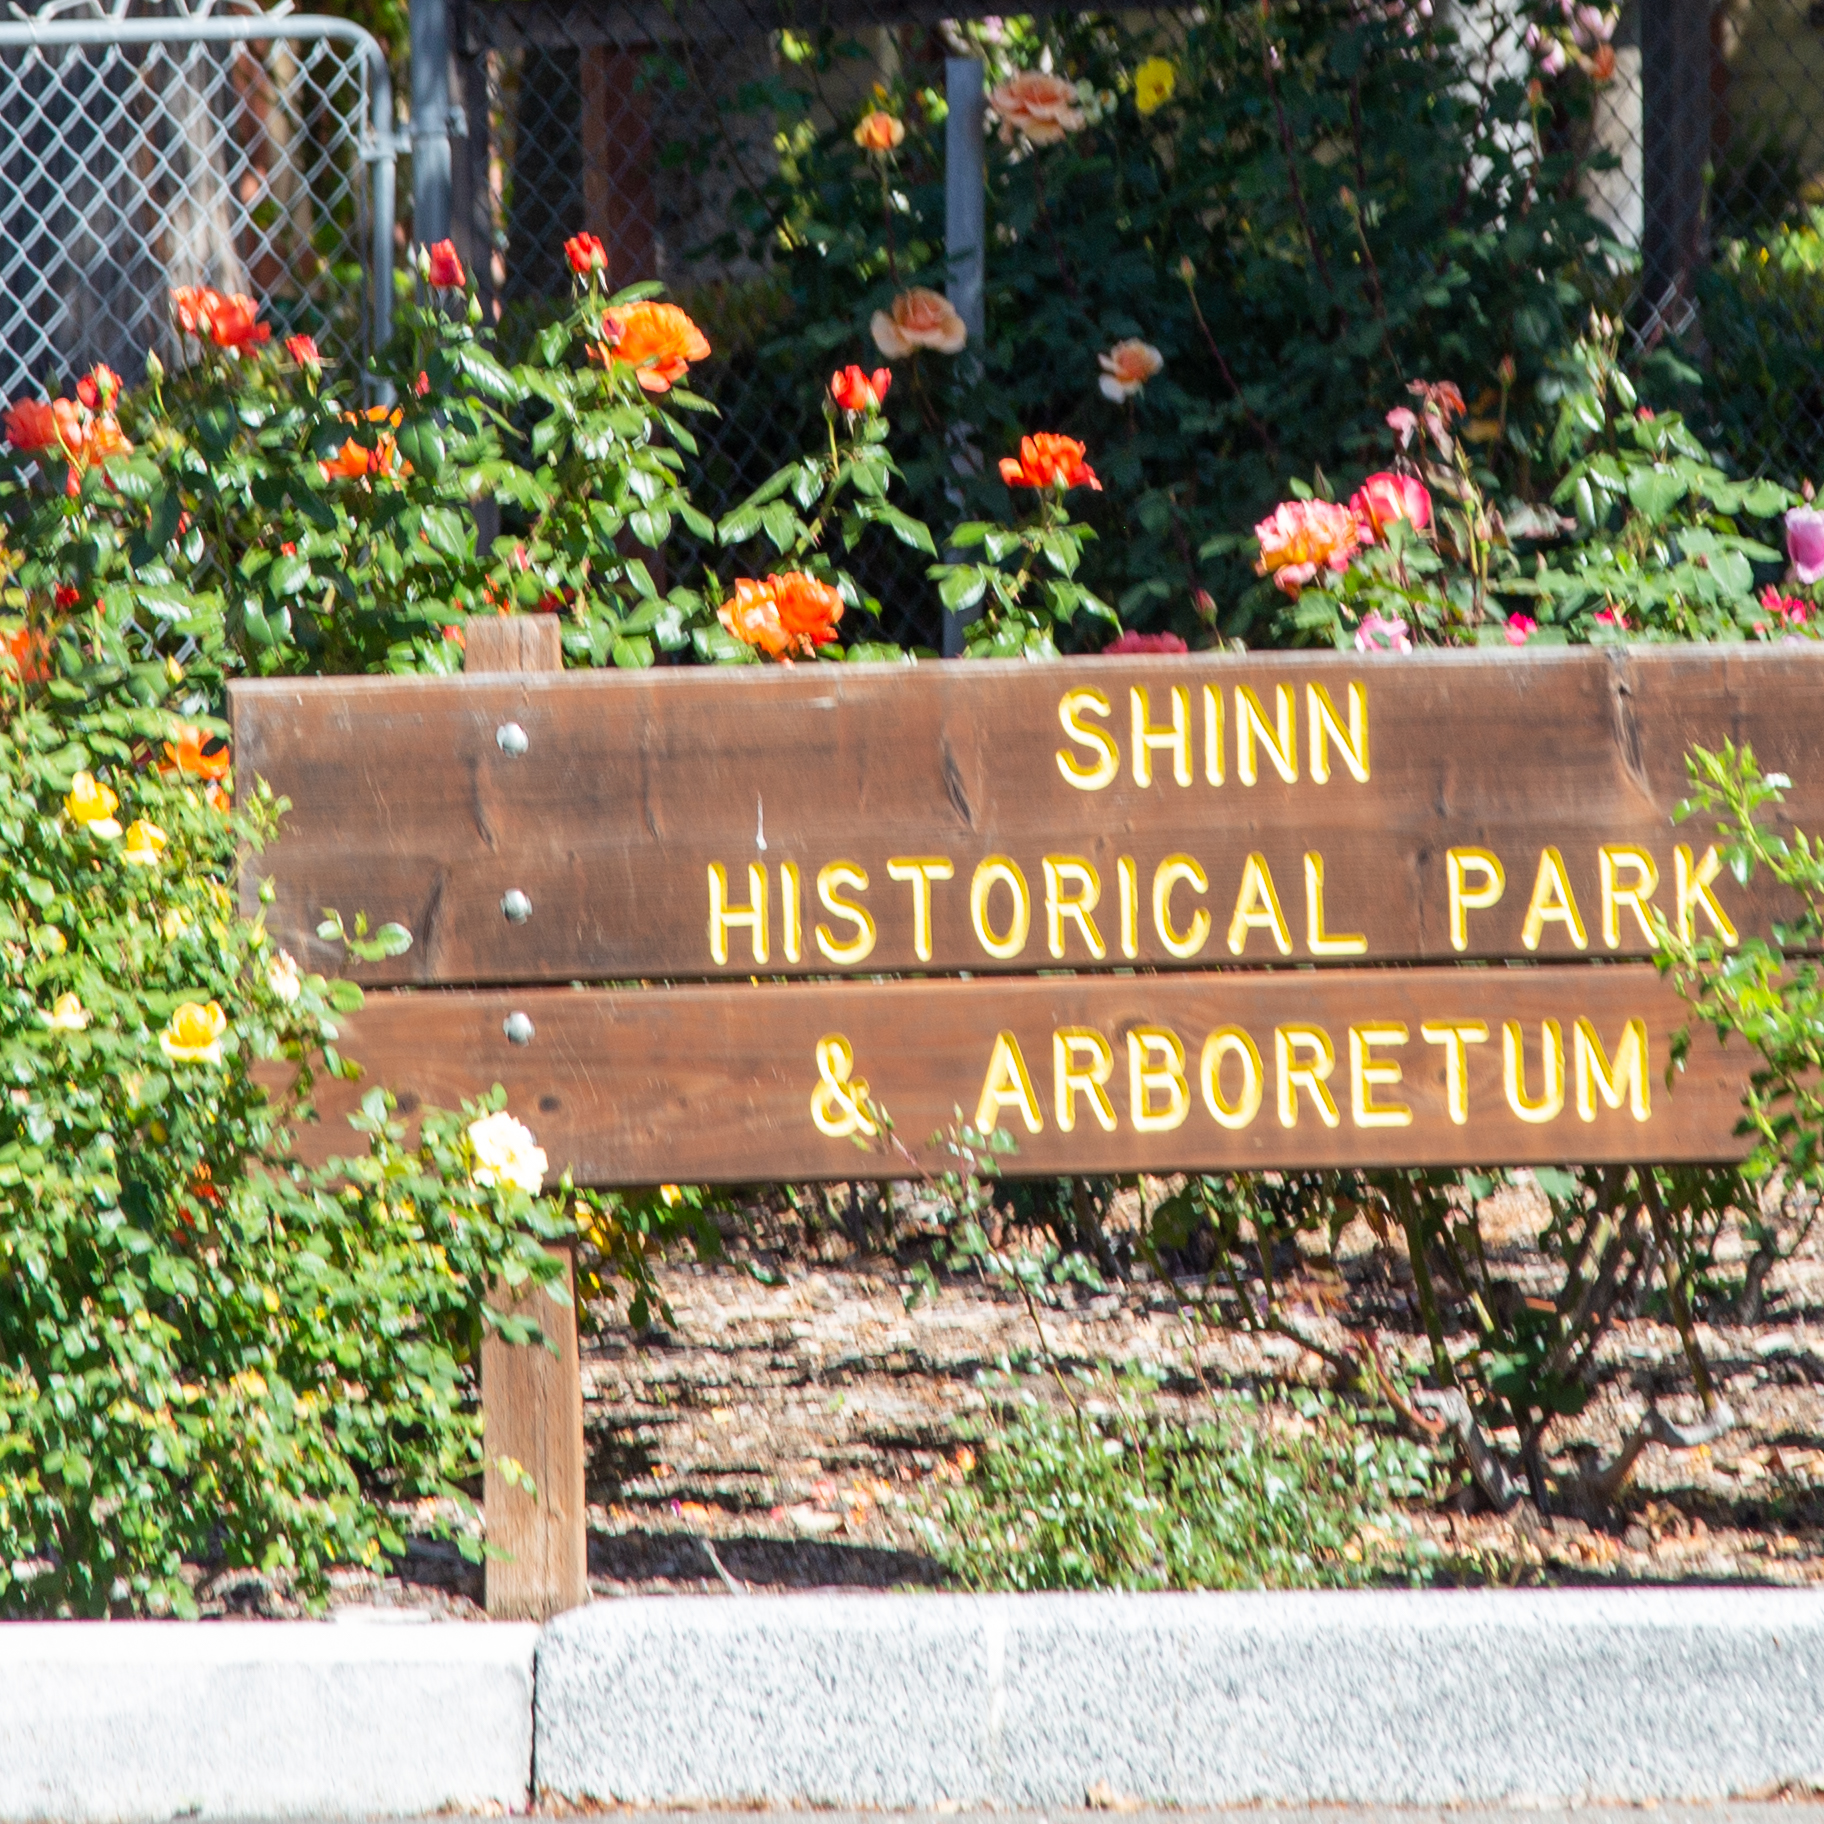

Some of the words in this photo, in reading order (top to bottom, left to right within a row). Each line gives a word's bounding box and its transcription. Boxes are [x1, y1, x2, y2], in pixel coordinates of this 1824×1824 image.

[1056, 681, 1370, 791] SHINN
[707, 851, 1367, 965] HISTORICAL
[1446, 843, 1739, 951] PARK
[810, 1032, 879, 1137] &
[975, 1016, 1652, 1135] ARBORETUM
